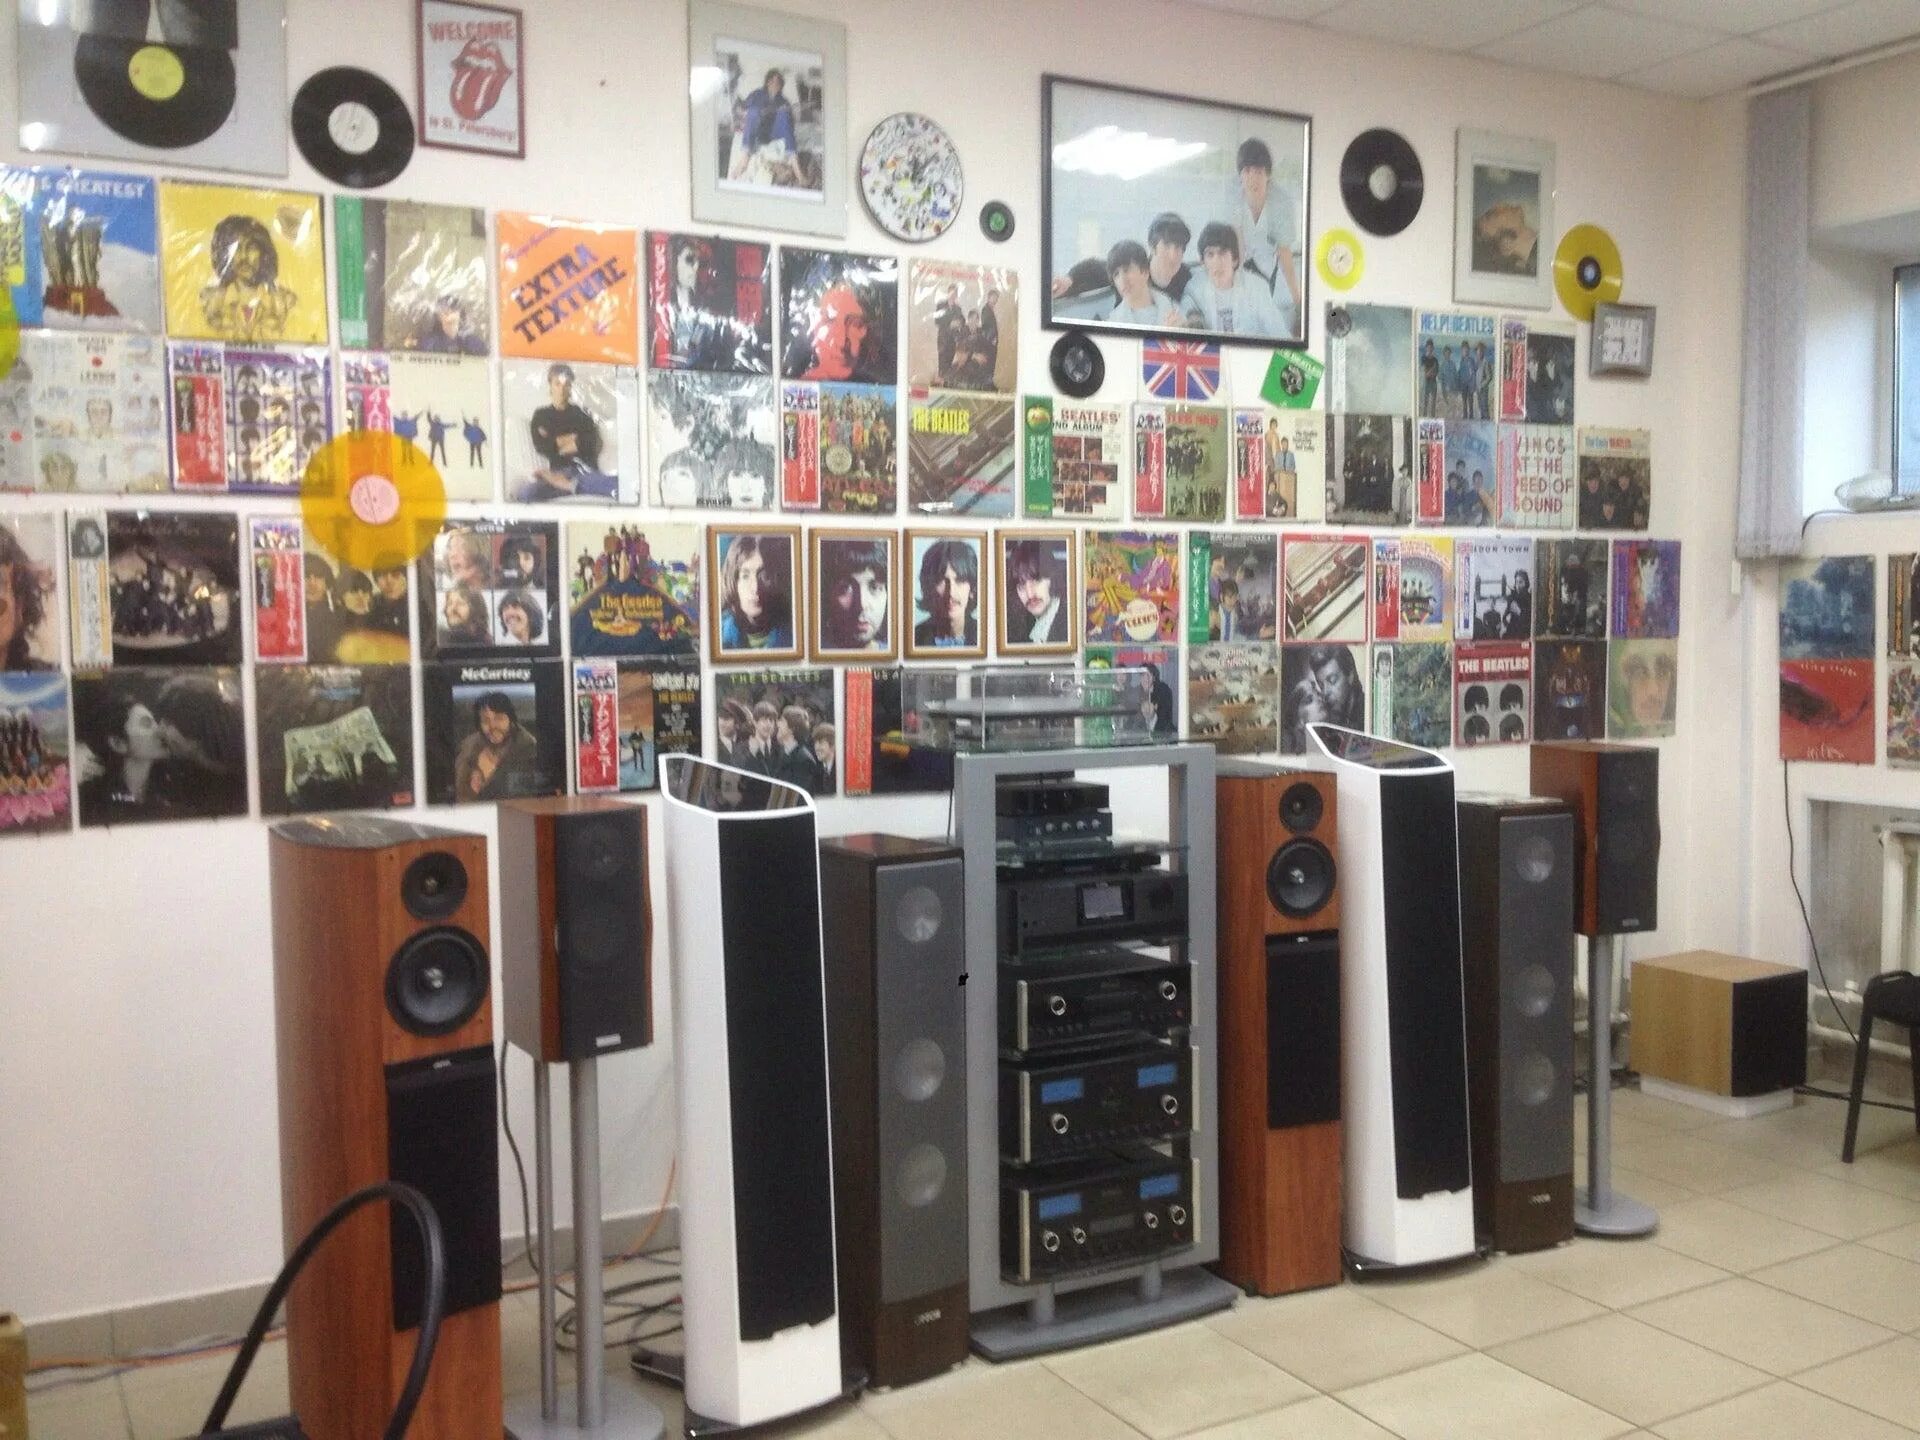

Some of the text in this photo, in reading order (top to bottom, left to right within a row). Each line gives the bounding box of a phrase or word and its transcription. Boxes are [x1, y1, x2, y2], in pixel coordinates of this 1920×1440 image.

[427, 21, 514, 41] WELCOME
[511, 243, 599, 312] EXTRA
[513, 256, 628, 344] TEXTURE
[931, 407, 970, 435] BEATLES
[461, 666, 531, 684] McCartney
[1458, 656, 1529, 674] THE BEATLES
[761, 670, 821, 684] BEATLES
